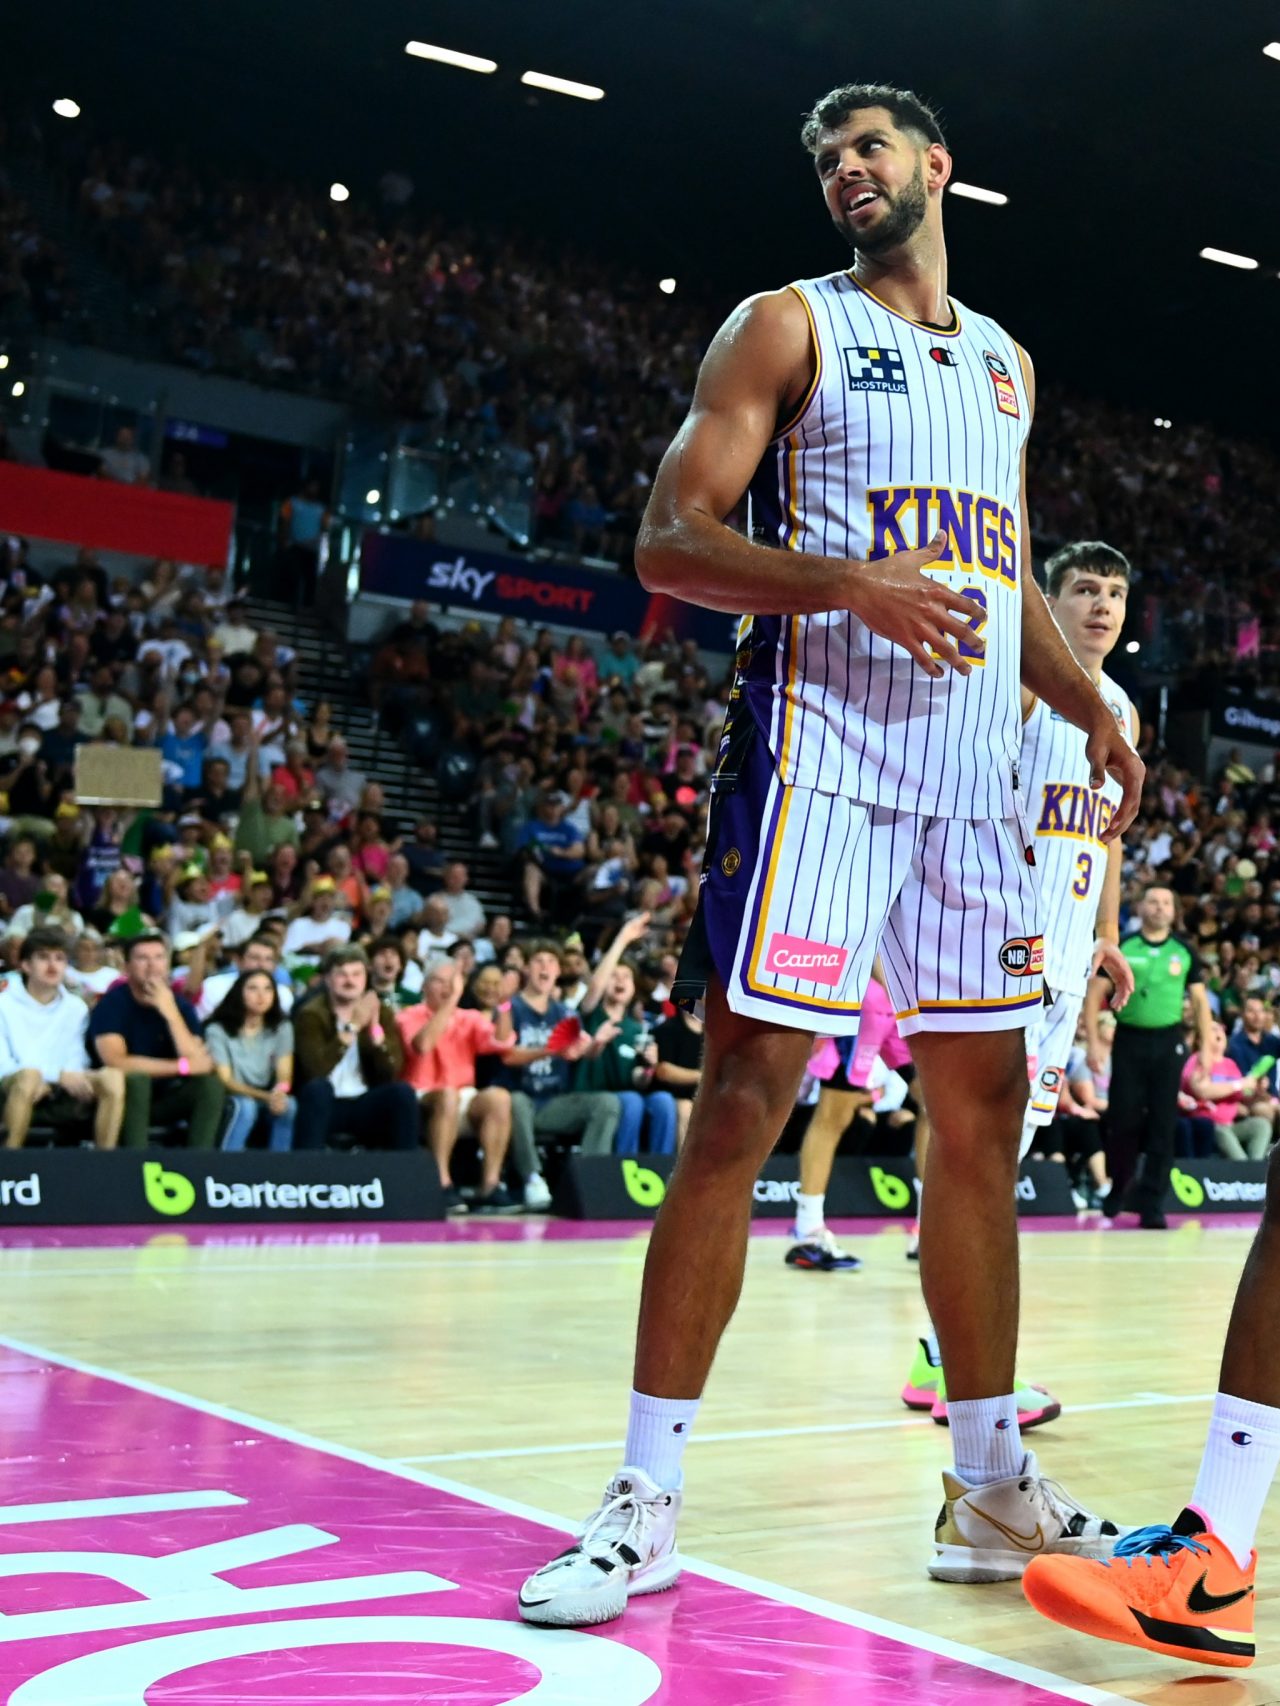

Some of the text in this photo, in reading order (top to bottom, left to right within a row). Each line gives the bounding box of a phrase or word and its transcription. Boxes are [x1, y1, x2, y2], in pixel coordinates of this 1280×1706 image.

[851, 380, 907, 393] HOSTPLUS
[867, 486, 1017, 590] KINGS
[426, 555, 595, 613] sky SPORT
[1071, 851, 1093, 901] 3
[773, 949, 840, 968] Carma
[205, 1175, 384, 1209] bartercard
